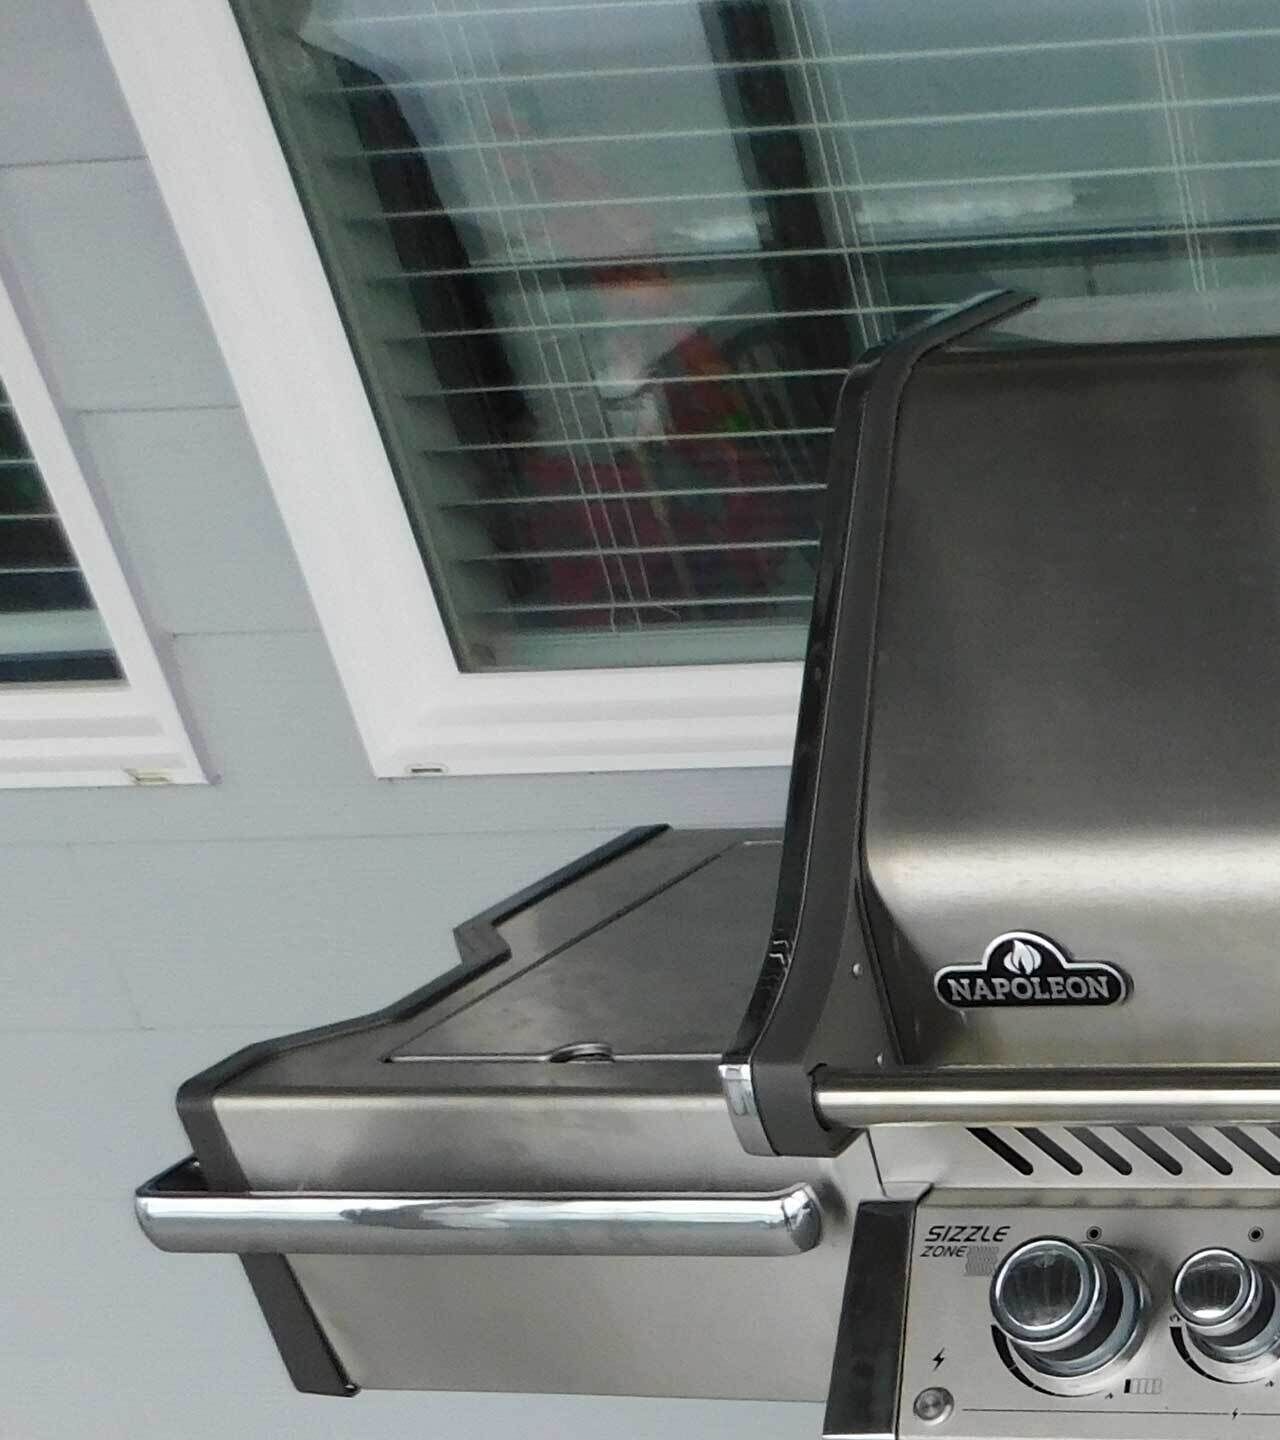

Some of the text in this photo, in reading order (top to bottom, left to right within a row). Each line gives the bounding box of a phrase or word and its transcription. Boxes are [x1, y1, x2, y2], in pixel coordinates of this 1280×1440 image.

[947, 975, 1111, 1001] NAPOLEON
[924, 1225, 1012, 1243] SIZZLE
[920, 1245, 968, 1258] ZONE
